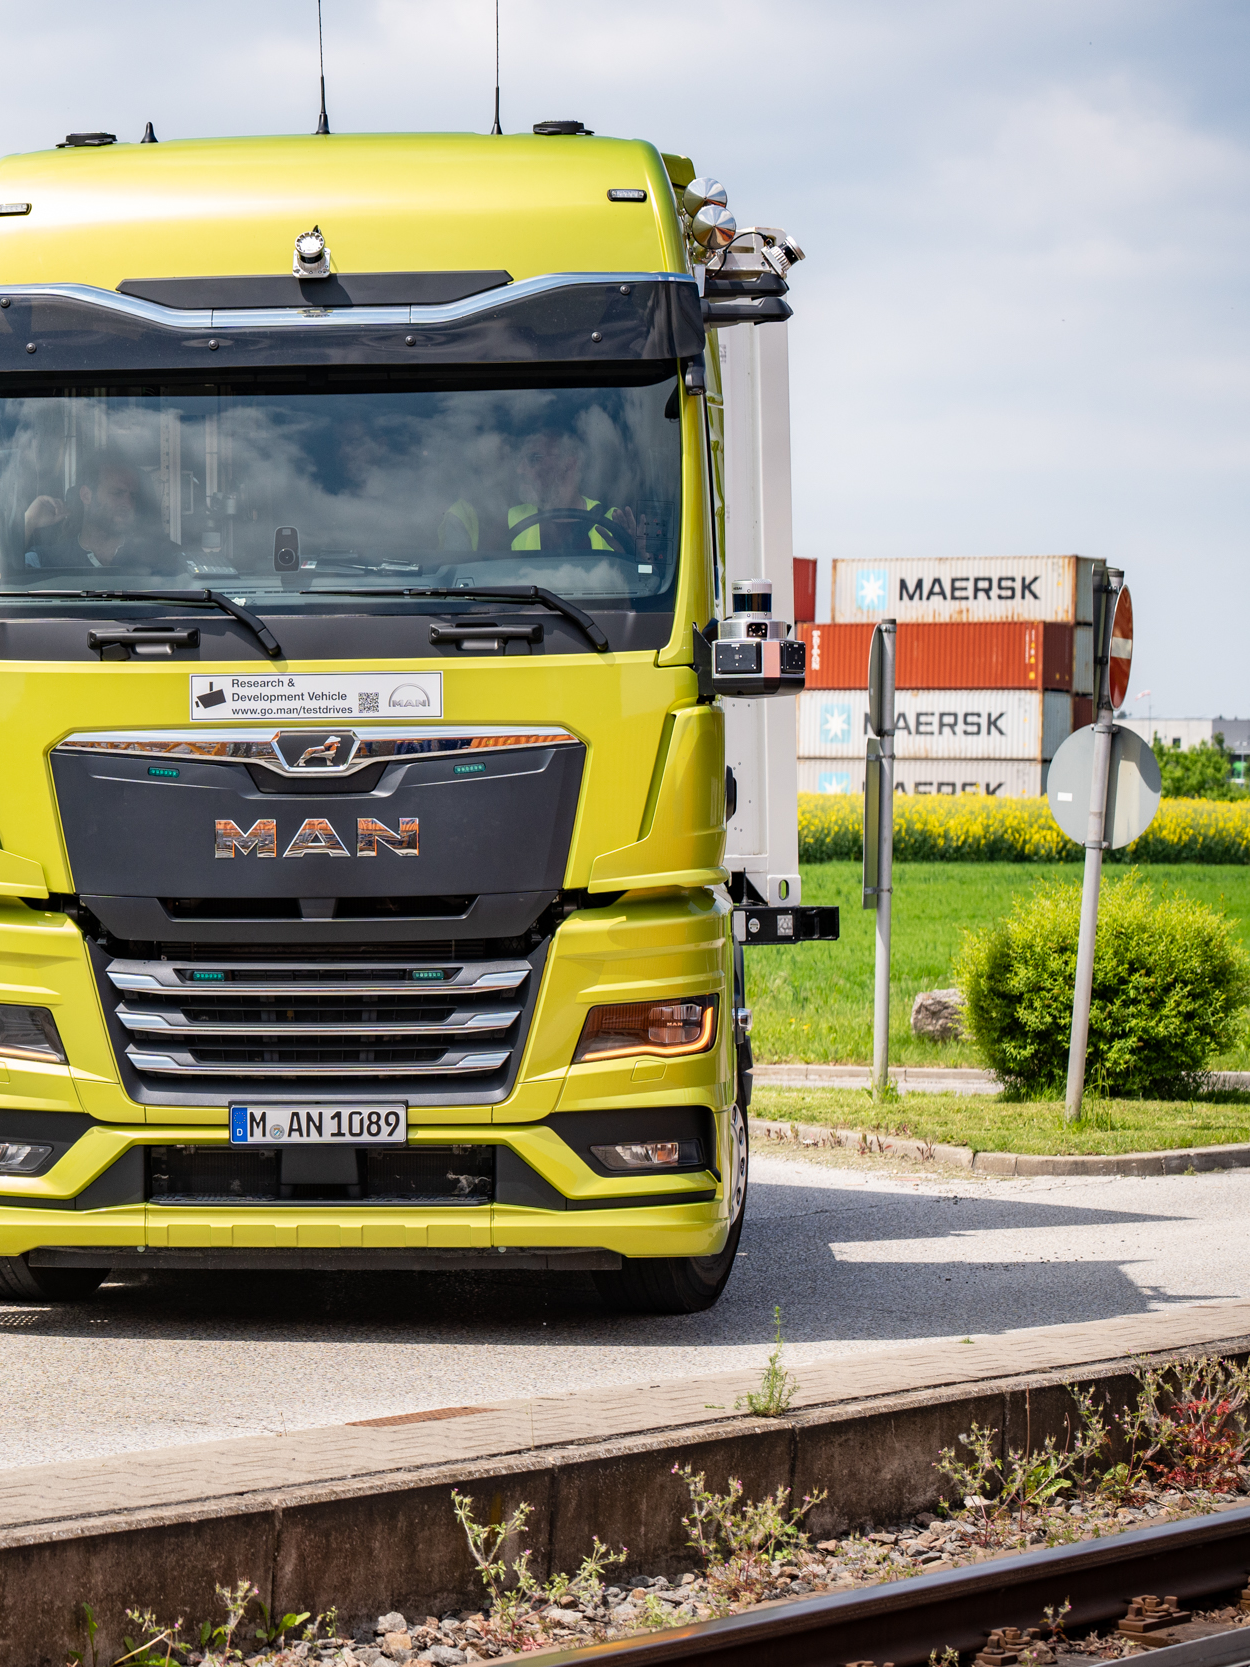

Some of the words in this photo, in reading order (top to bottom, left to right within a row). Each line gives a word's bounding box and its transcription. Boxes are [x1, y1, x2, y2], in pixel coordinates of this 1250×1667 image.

[899, 575, 1041, 601] MAERSK
[232, 678, 284, 688] Research
[287, 678, 295, 687] &
[232, 692, 305, 703] Development
[308, 691, 348, 701] Vehicle
[392, 699, 426, 708] MAN
[232, 705, 353, 716] www.go.man/testdrives
[864, 712, 1007, 736] AERSK
[215, 817, 419, 858] MAN
[236, 1128, 243, 1136] D
[249, 1111, 266, 1137] M
